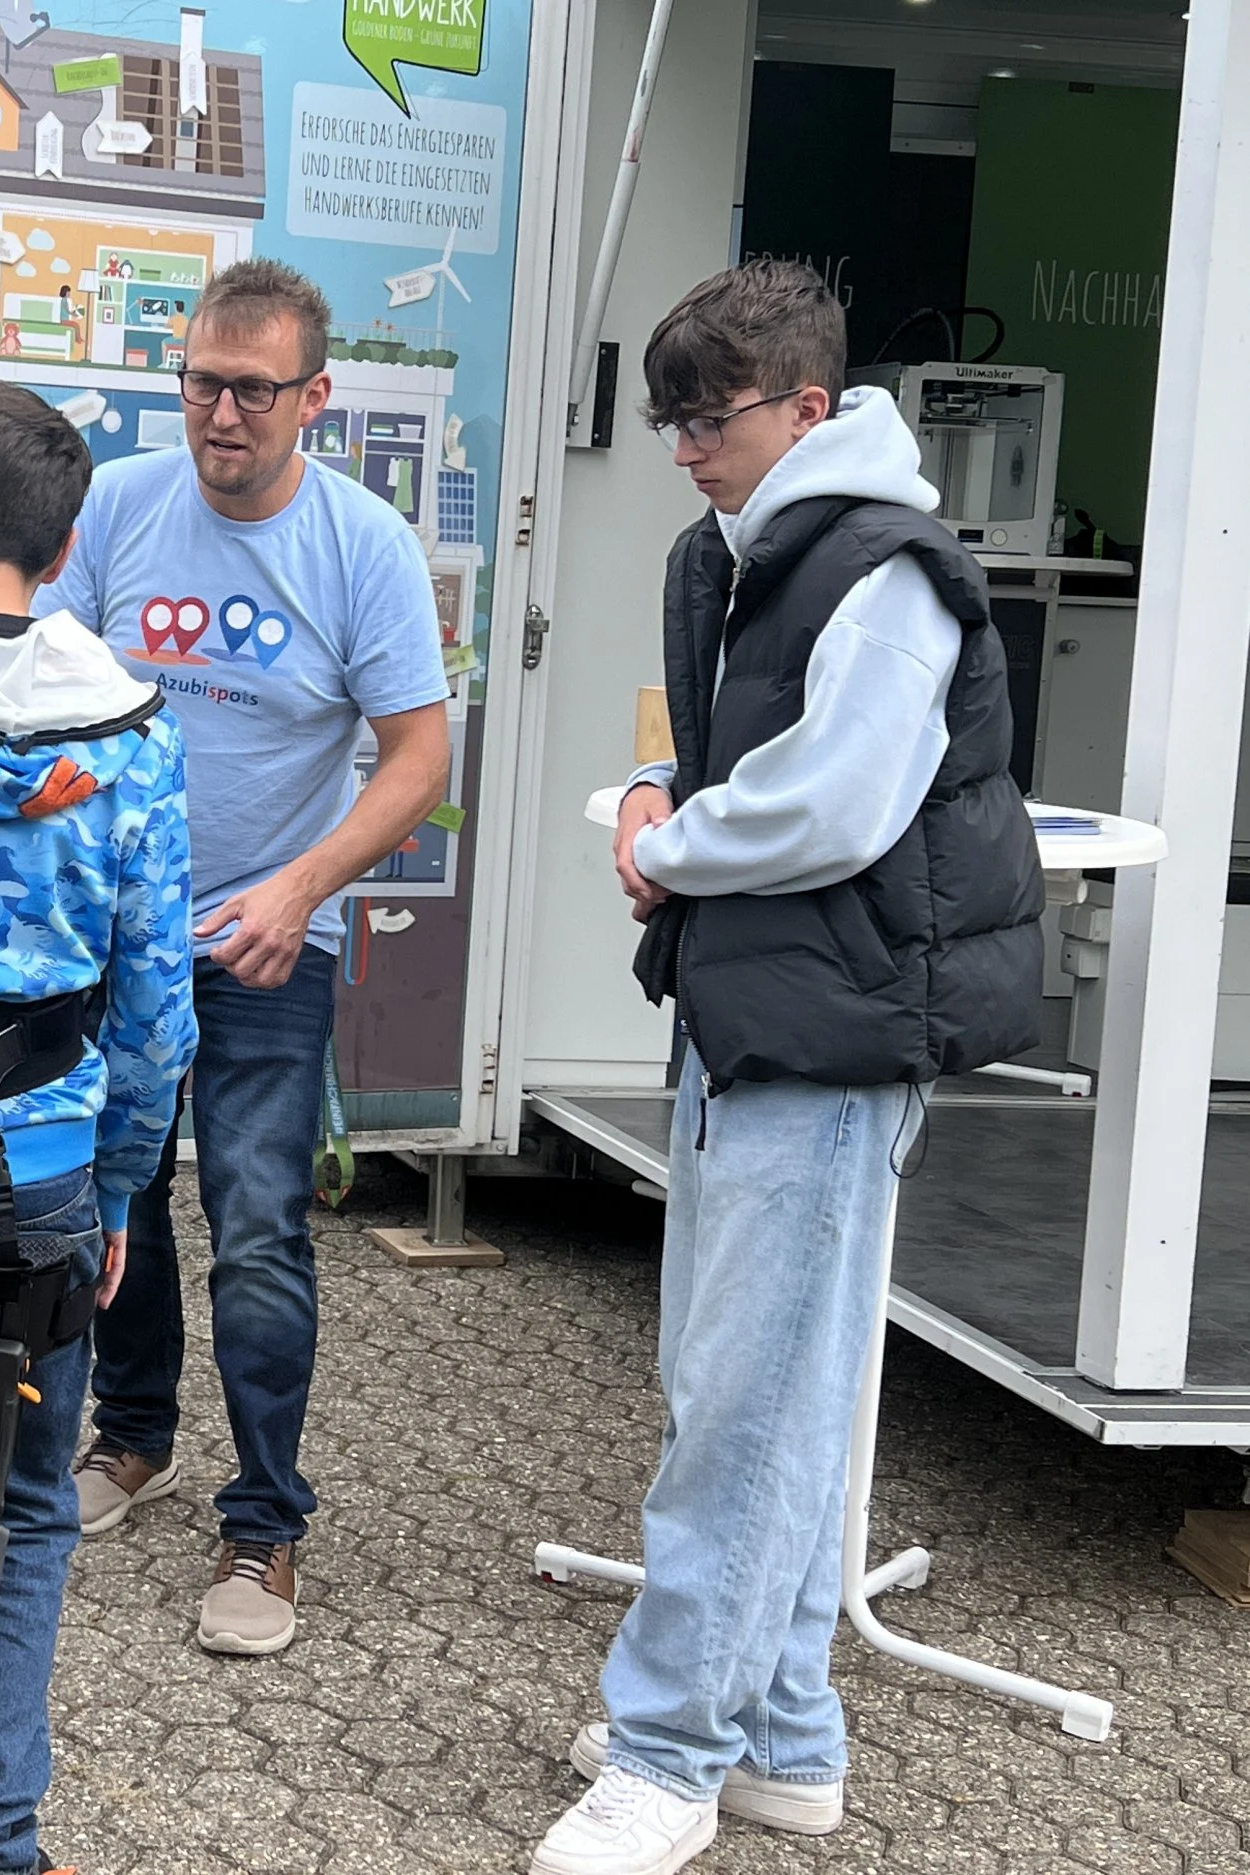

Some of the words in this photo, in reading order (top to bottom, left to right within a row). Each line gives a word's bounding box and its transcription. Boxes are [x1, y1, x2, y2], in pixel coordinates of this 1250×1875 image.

[302, 111, 365, 146] ERFORSCHE
[370, 123, 393, 148] DAS
[397, 122, 495, 160] ENERGIESPAREN
[302, 153, 330, 178] UND
[334, 156, 371, 182] LERNE
[376, 161, 397, 186] DIE
[401, 163, 491, 195] EINGESETZTEN
[304, 186, 422, 224] HANDWERKSBERUFE
[426, 201, 484, 231] KENNEN!
[1031, 259, 1162, 329] NACHHA
[156, 672, 258, 706] Azubispots
